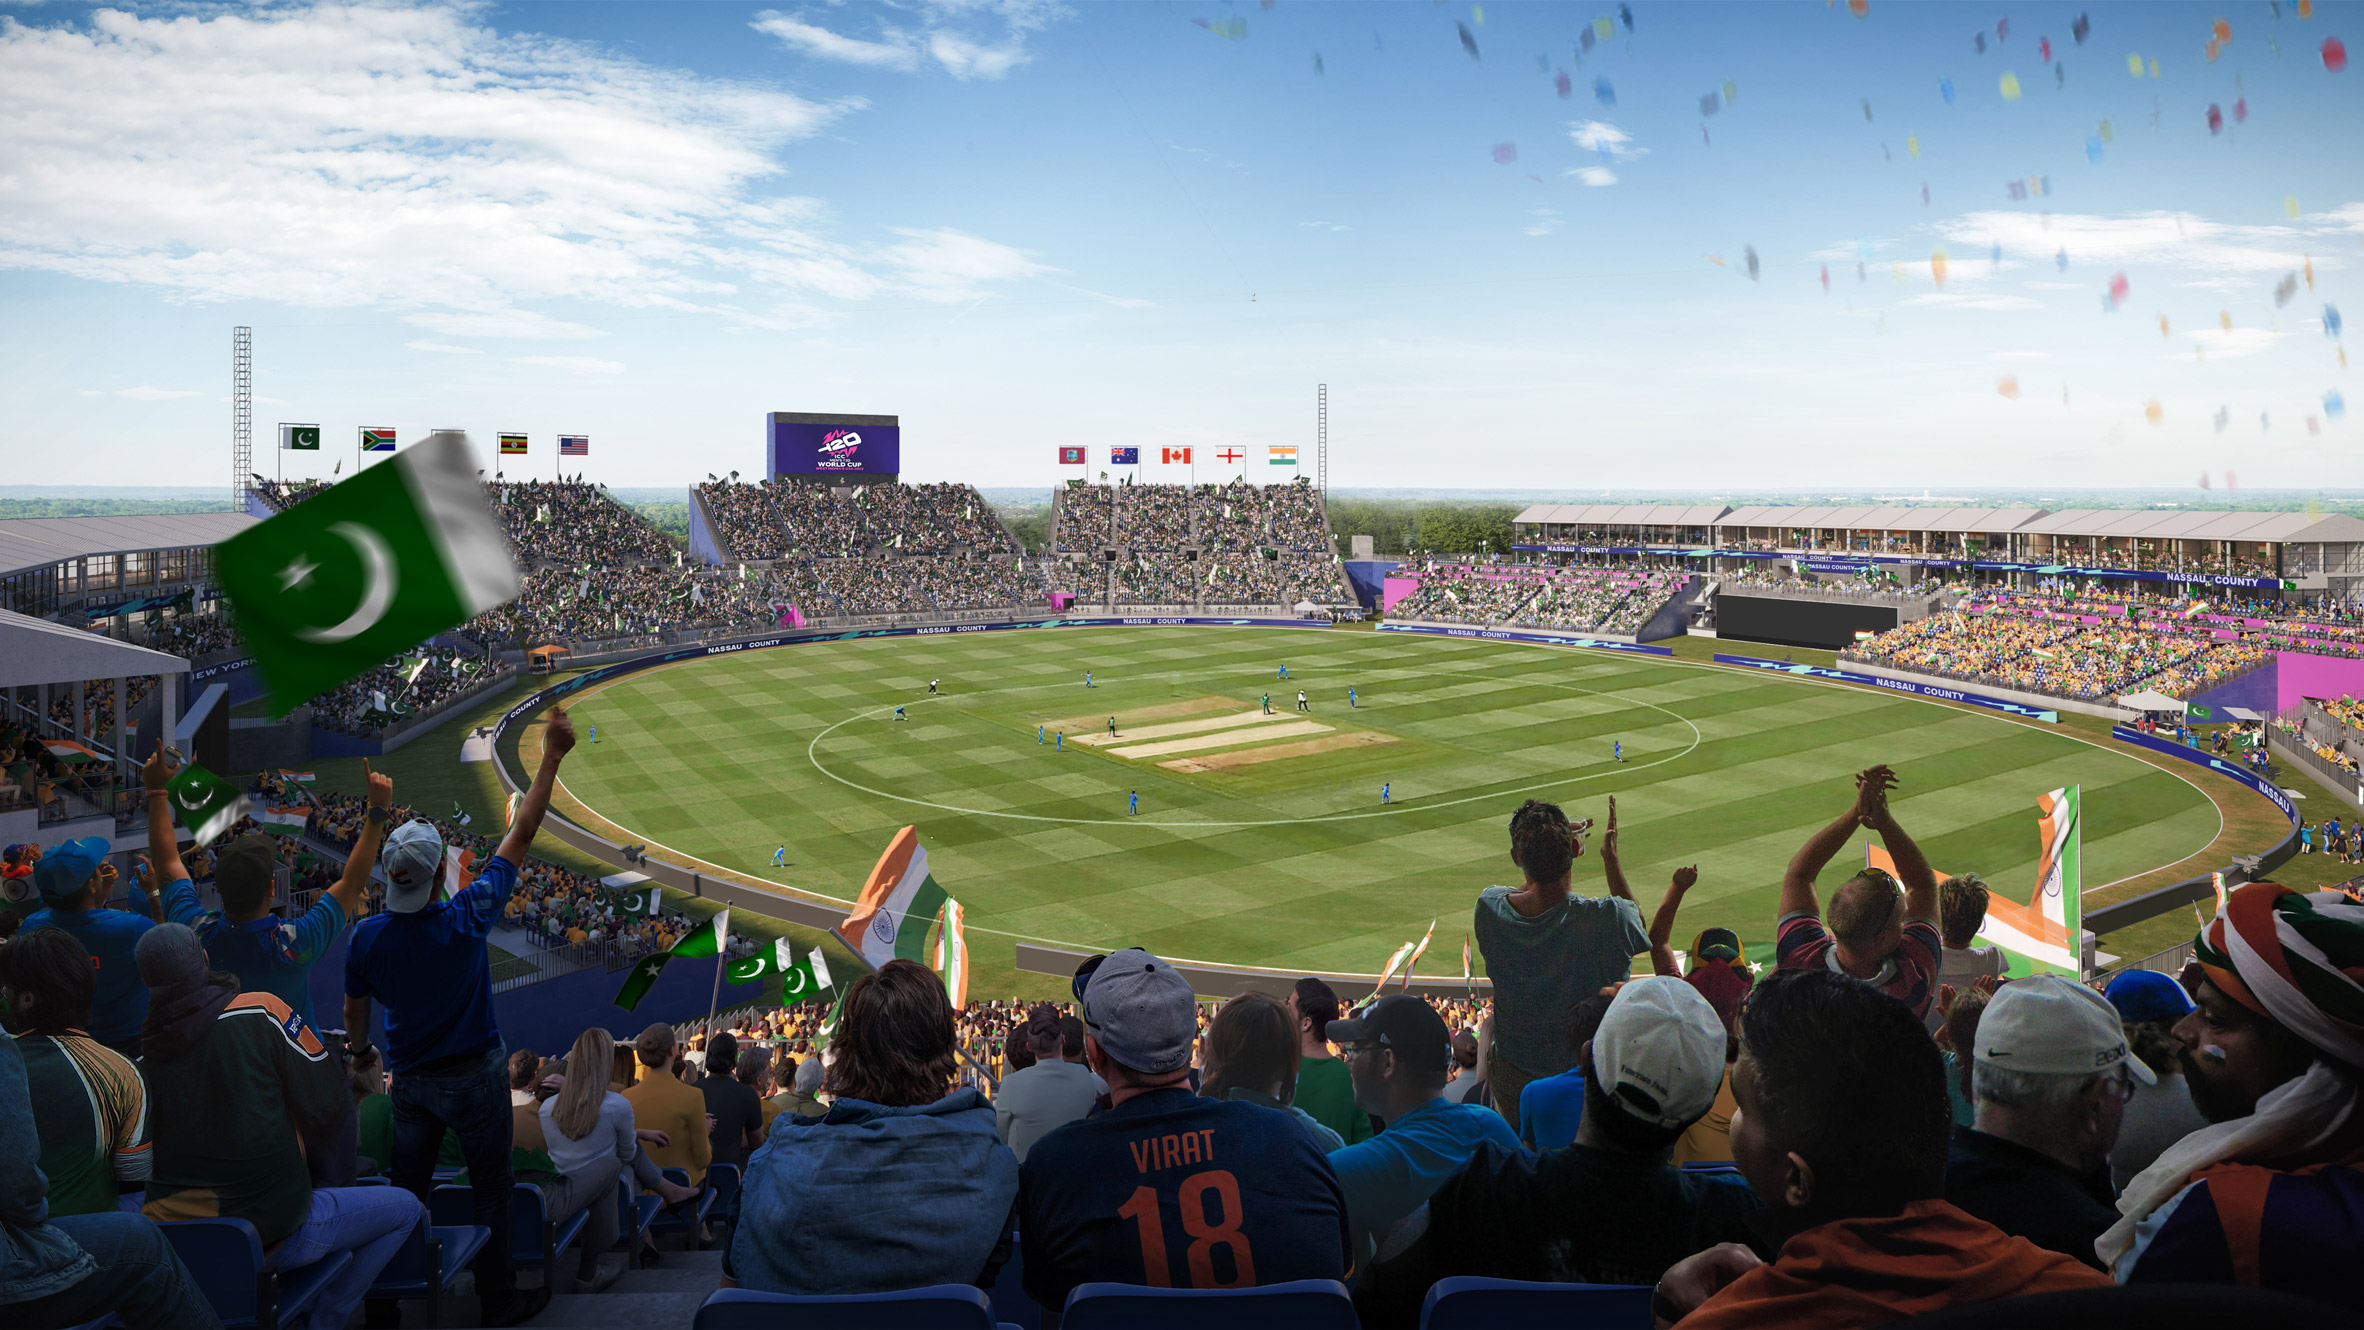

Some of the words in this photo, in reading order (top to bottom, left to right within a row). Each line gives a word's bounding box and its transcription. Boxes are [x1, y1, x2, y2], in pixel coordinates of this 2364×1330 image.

[818, 432, 862, 453] T20
[2167, 573, 2206, 583] NASSAU
[2215, 576, 2258, 586] COUNTY
[917, 626, 950, 635] NASSAU
[1447, 629, 1476, 637] NASSAU
[1481, 631, 1511, 639] COUNTY
[708, 643, 742, 654] NASSAU
[749, 639, 780, 648] COUNTY
[1876, 678, 1915, 691] NASSAU
[1924, 687, 1964, 700] COUNTY
[510, 696, 541, 718] COUNTY
[2258, 780, 2290, 813] NASSAU
[1129, 1129, 1215, 1175] VIRAT
[1117, 1169, 1257, 1288] 18
